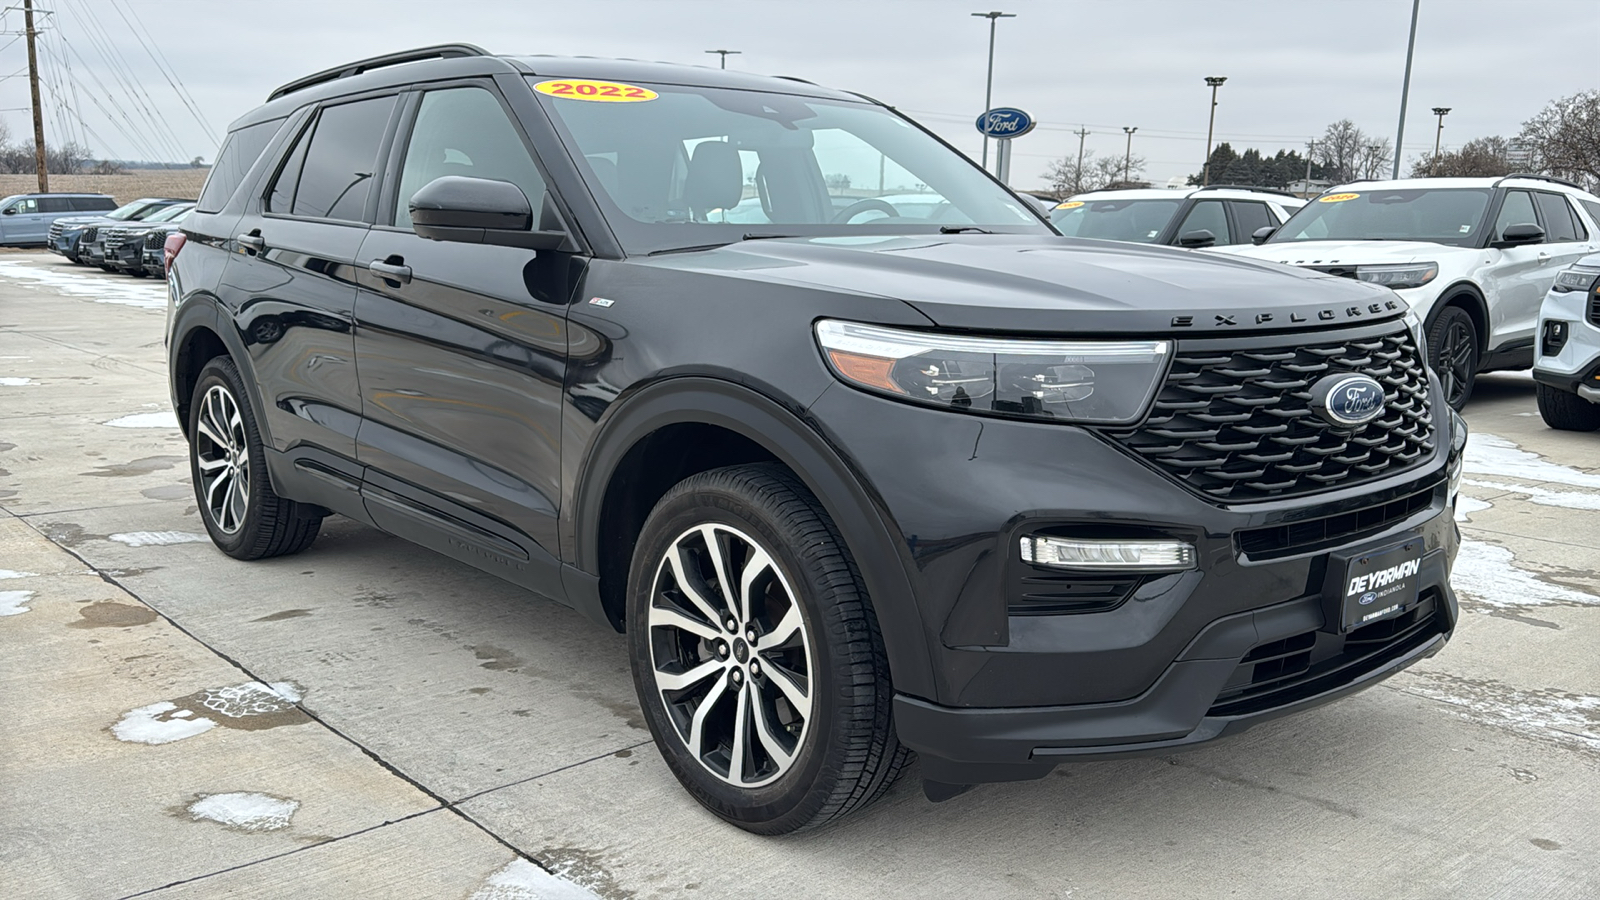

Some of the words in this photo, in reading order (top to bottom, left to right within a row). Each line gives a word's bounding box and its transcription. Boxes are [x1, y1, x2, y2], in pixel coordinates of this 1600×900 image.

[551, 83, 646, 98] 2022
[987, 113, 1019, 132] Ford
[1171, 300, 1398, 328] EXPLORER
[1345, 387, 1376, 413] Ford
[1347, 558, 1421, 597] DEYARMAN
[1377, 583, 1406, 598] INDIANOLA
